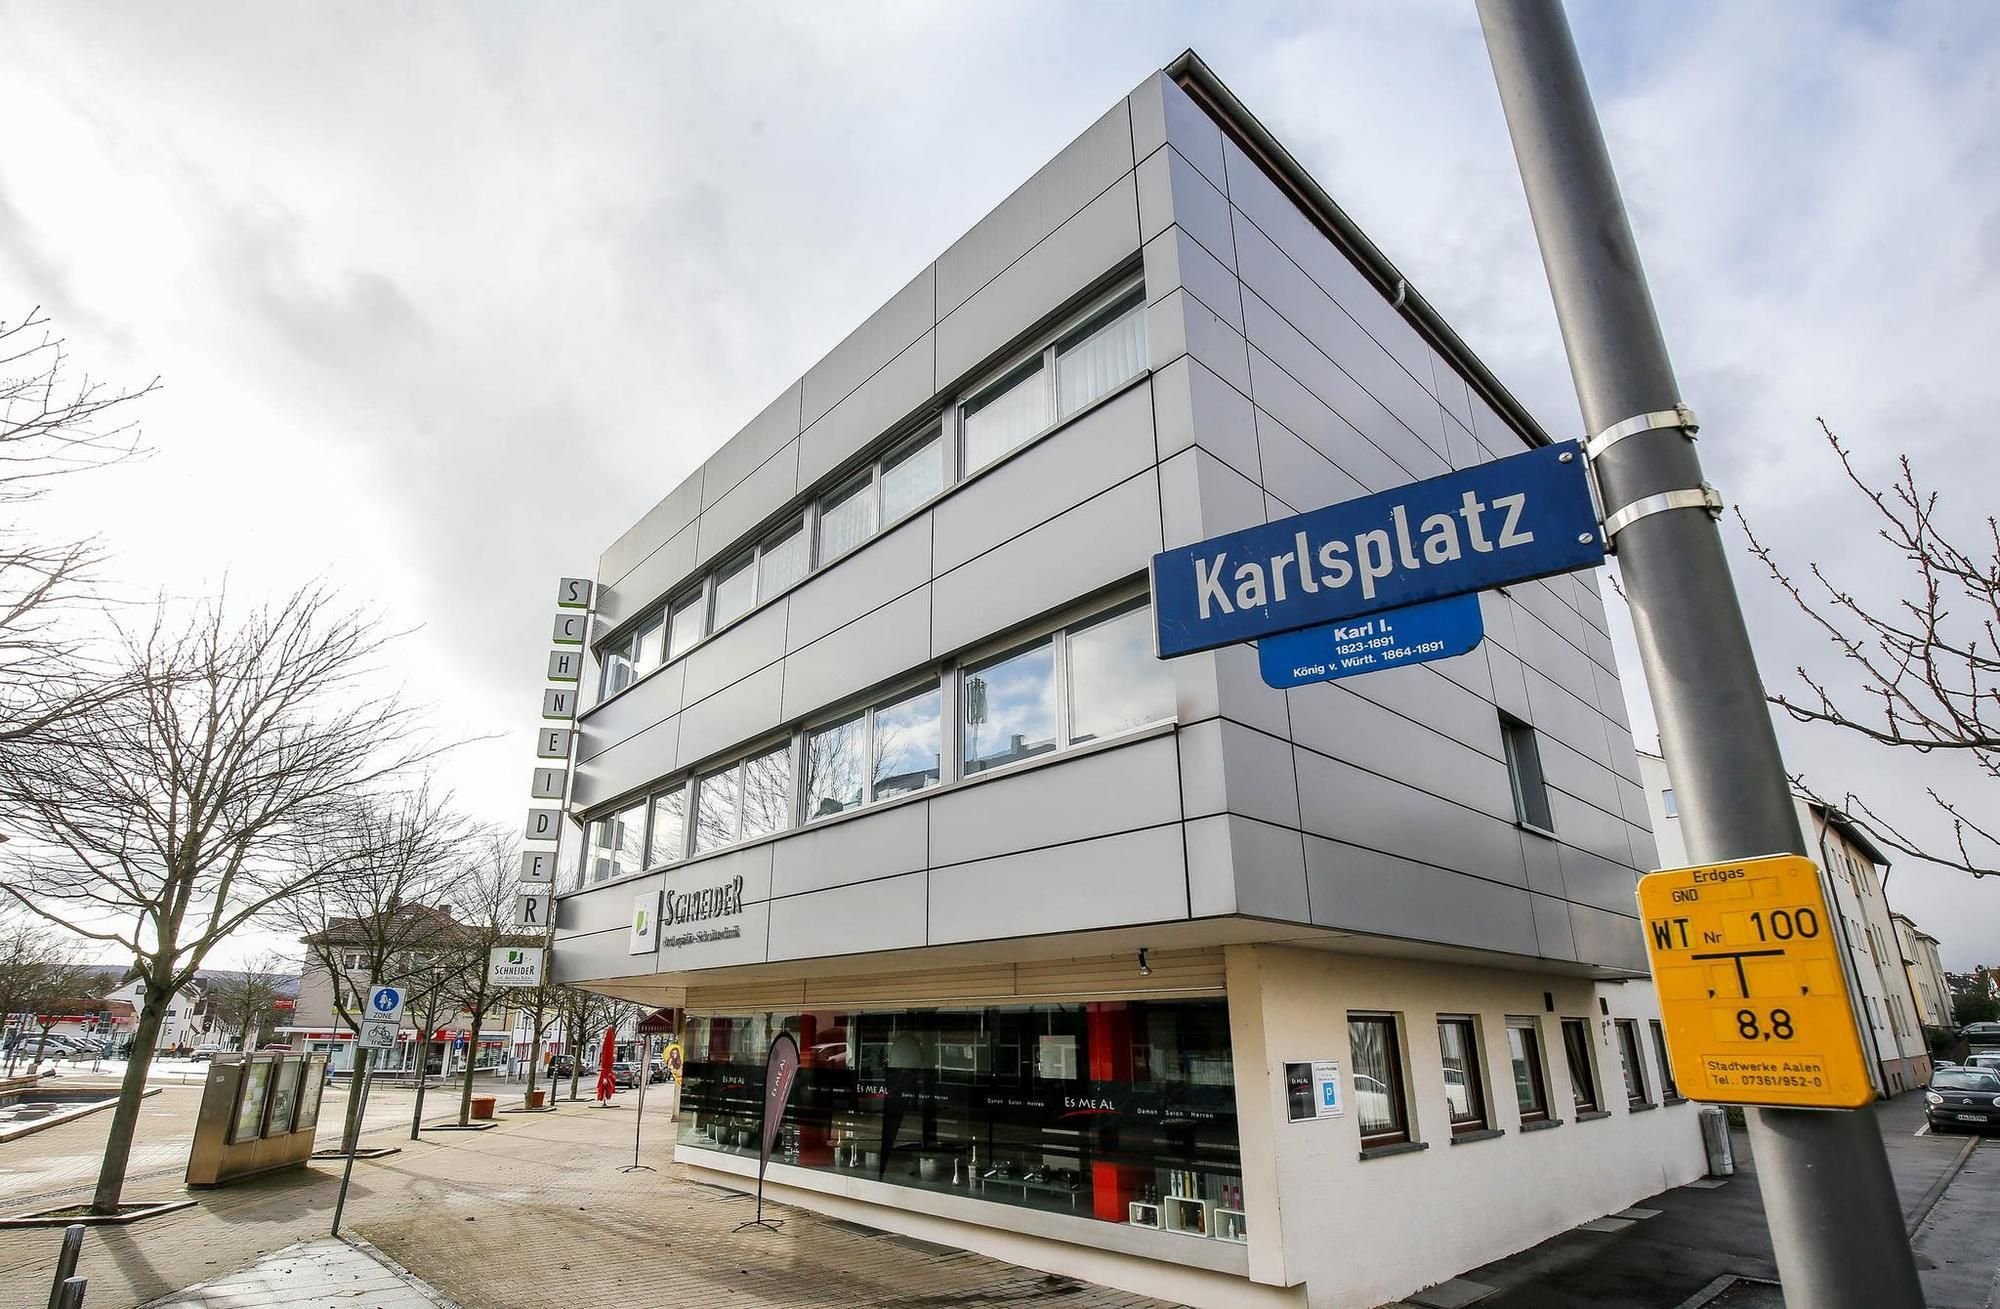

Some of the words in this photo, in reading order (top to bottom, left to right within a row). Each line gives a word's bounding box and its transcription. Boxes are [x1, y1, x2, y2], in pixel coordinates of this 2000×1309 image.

[1194, 490, 1535, 620] Karlsplatz
[1334, 622, 1373, 641] Karl
[1378, 619, 1392, 634] I.
[1335, 635, 1395, 655] 1823-1891
[1293, 664, 1325, 678] König
[1328, 662, 1338, 671] v.
[1341, 654, 1377, 668] Württ.
[1381, 640, 1445, 661] 1864-1891
[524, 579, 580, 924] SCHNEIDER
[1693, 868, 1745, 884] Erdgas
[664, 874, 743, 926] SCHNEIDER
[1672, 888, 1699, 903] GND
[1652, 918, 1689, 950] WT
[1704, 931, 1723, 944] Nr
[1750, 907, 1819, 942] 100
[494, 965, 535, 975] SCHNEIDER
[1736, 1009, 1794, 1042] 8,8
[1708, 1061, 1777, 1072] Stadtwerke
[1783, 1062, 1821, 1072] Aalen
[1326, 1086, 1333, 1101] P
[1078, 1098, 1097, 1109] ME
[1099, 1099, 1115, 1111] AL
